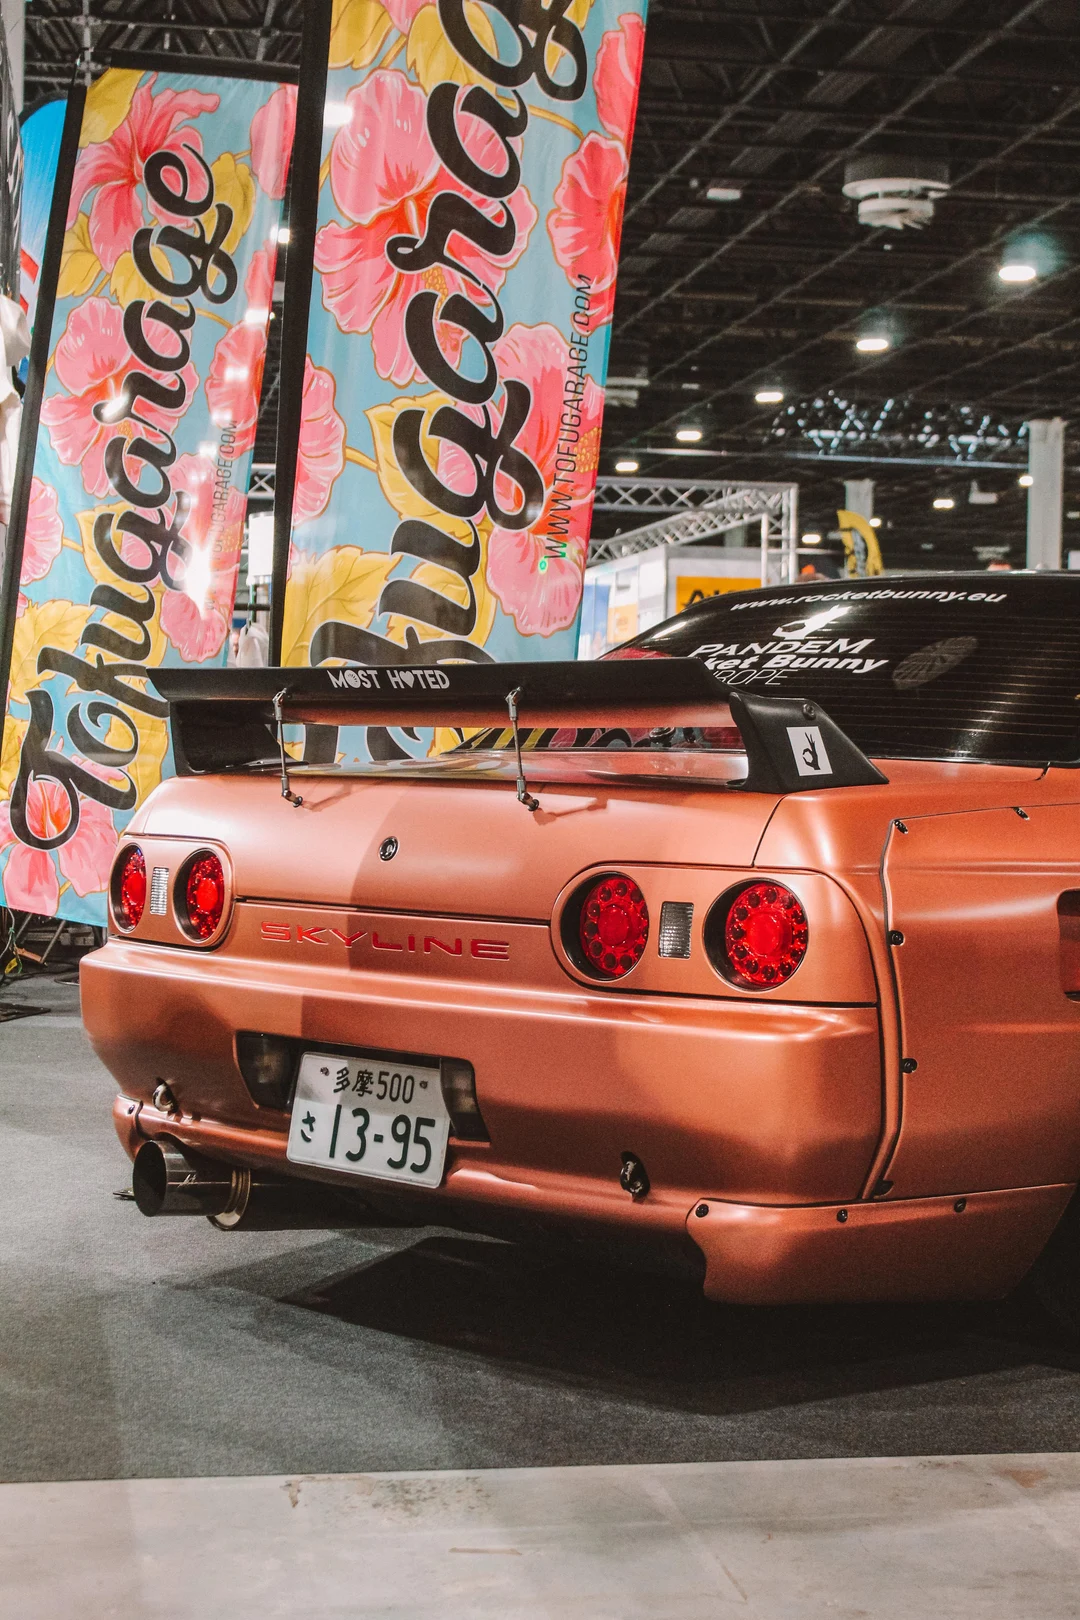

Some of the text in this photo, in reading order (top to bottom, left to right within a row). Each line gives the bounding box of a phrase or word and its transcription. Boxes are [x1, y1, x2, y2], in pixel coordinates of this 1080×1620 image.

[544, 274, 592, 559] WWW.TOFUGARAGE.COM
[10, 142, 238, 850] Tofugarage
[730, 589, 1007, 611] www.rocketbunny.eu
[688, 638, 875, 657] PANDEM
[704, 654, 889, 674] ket Bunny
[327, 669, 381, 689] MOST
[713, 669, 798, 686] ROPE
[261, 921, 510, 961] SKYLINE
[329, 1103, 436, 1174] 13-95
